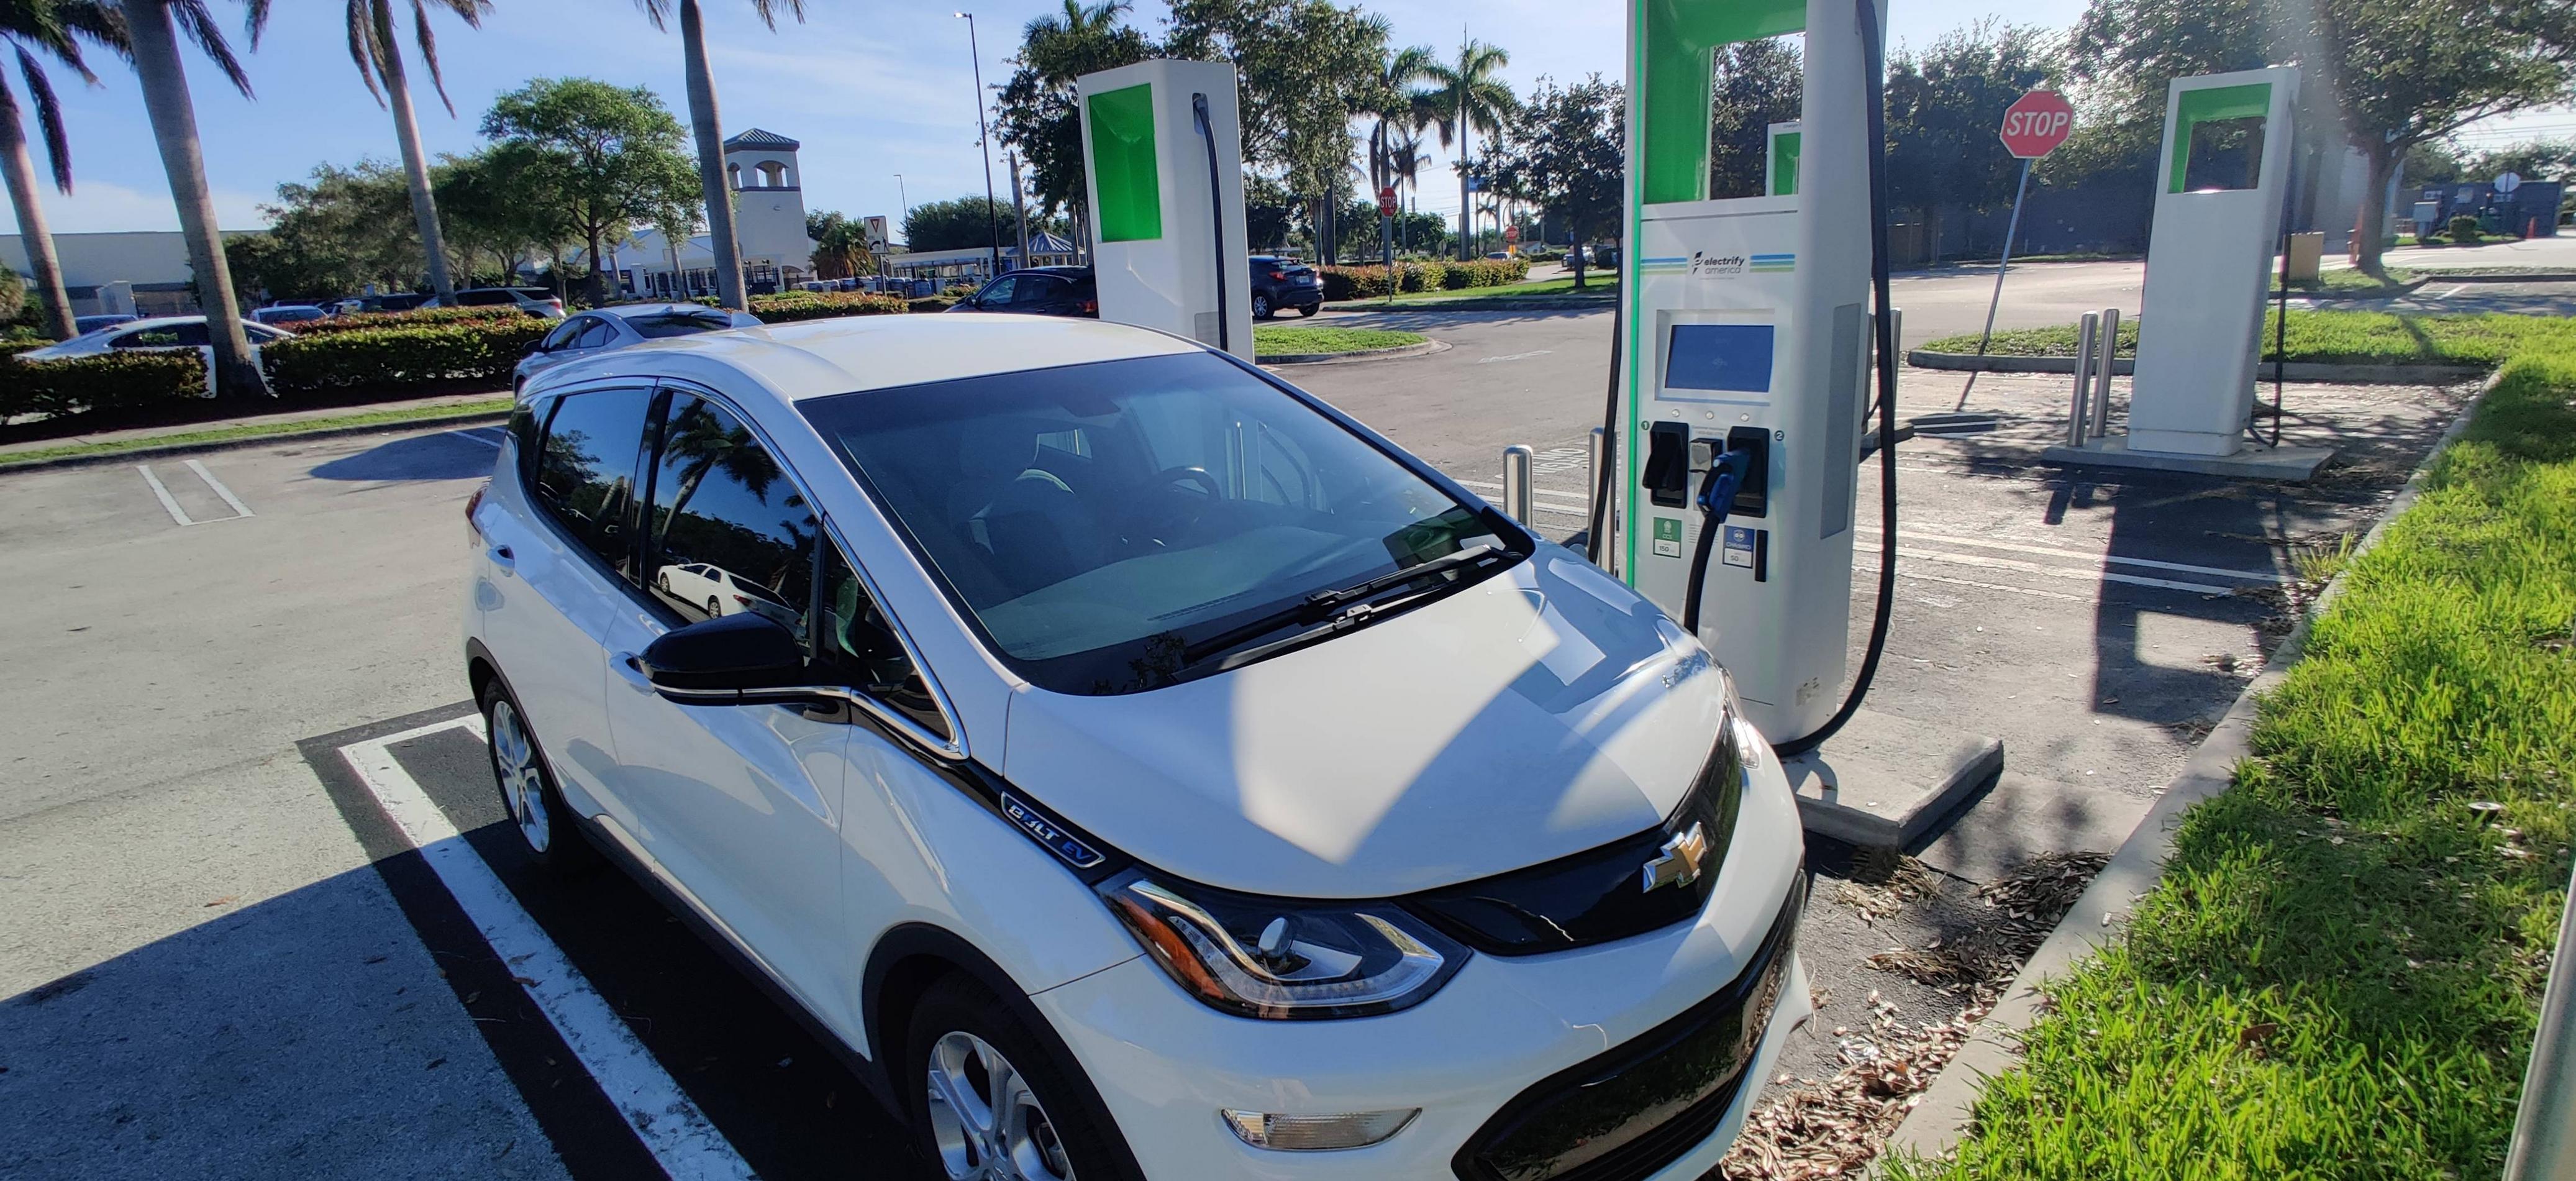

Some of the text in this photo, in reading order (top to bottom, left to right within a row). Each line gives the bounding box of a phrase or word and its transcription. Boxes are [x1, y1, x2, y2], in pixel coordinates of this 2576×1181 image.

[2006, 111, 2069, 136] STOP
[1380, 196, 1396, 208] STOP
[1704, 256, 1745, 267] electrify
[1008, 805, 1091, 860] BOLT EV
